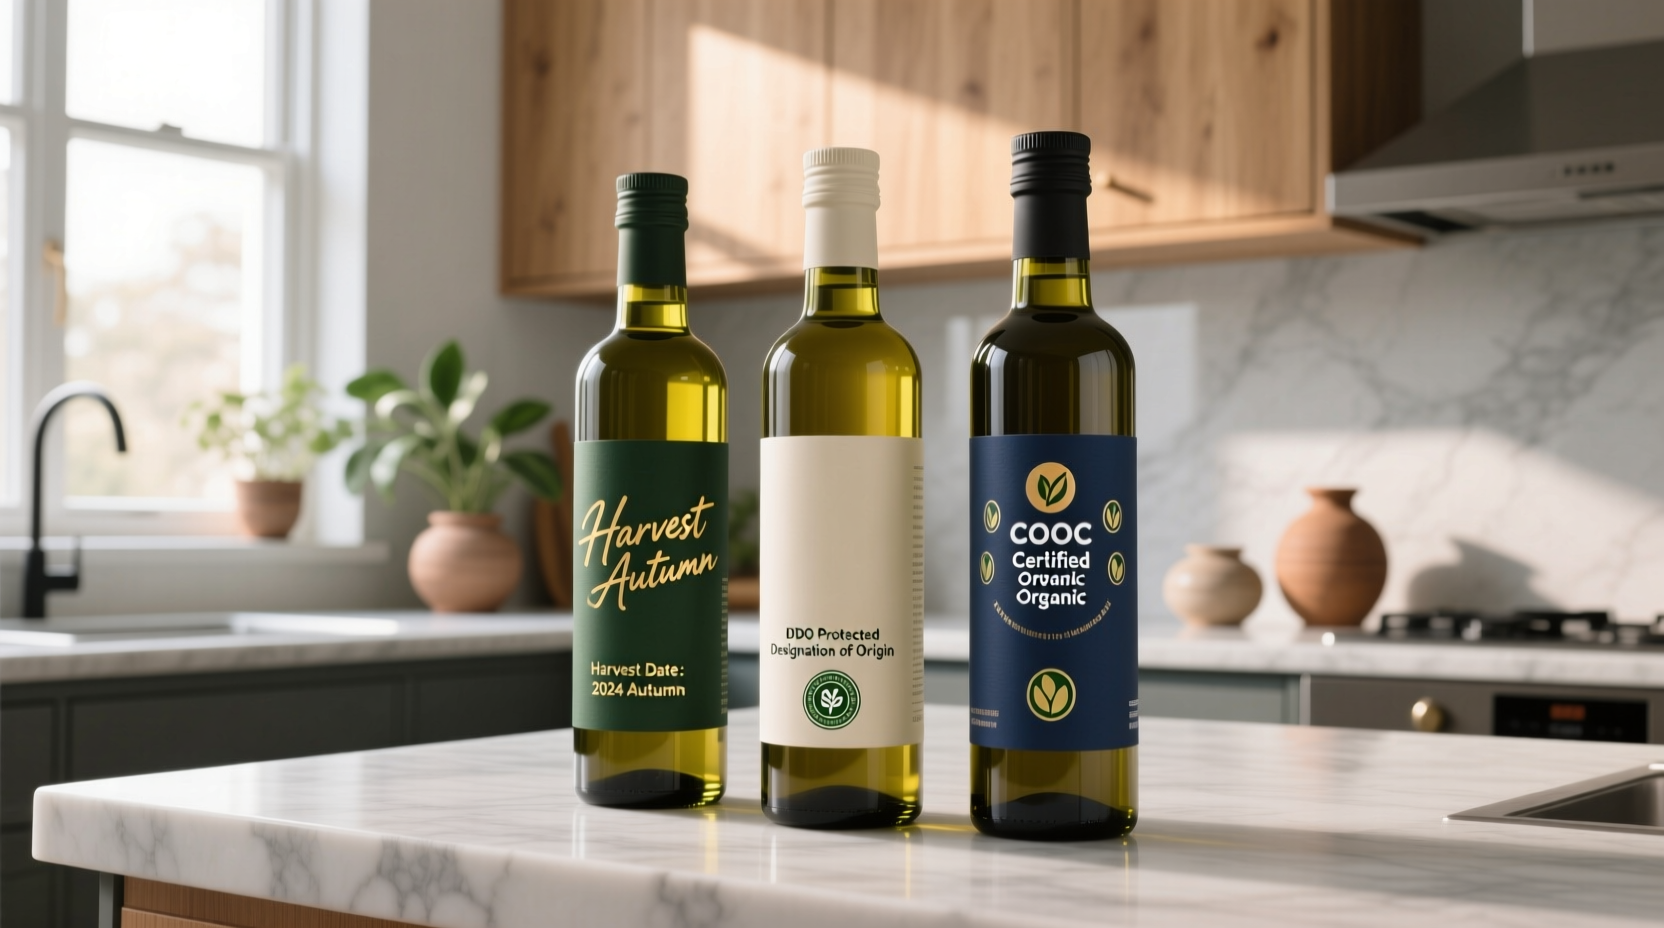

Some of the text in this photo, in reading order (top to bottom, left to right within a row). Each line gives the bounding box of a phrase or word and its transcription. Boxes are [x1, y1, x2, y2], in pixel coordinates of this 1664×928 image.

[578, 495, 715, 568] Harvest
[1009, 521, 1093, 546] COOC
[1012, 550, 1090, 569] Certified
[586, 550, 719, 612] Autumn
[1016, 588, 1087, 610] Organic
[817, 627, 880, 641] Protected
[839, 643, 854, 657] of
[856, 644, 895, 660] Origin
[590, 660, 685, 677] Harvest Date:
[591, 680, 686, 697] 2024 Autumn
